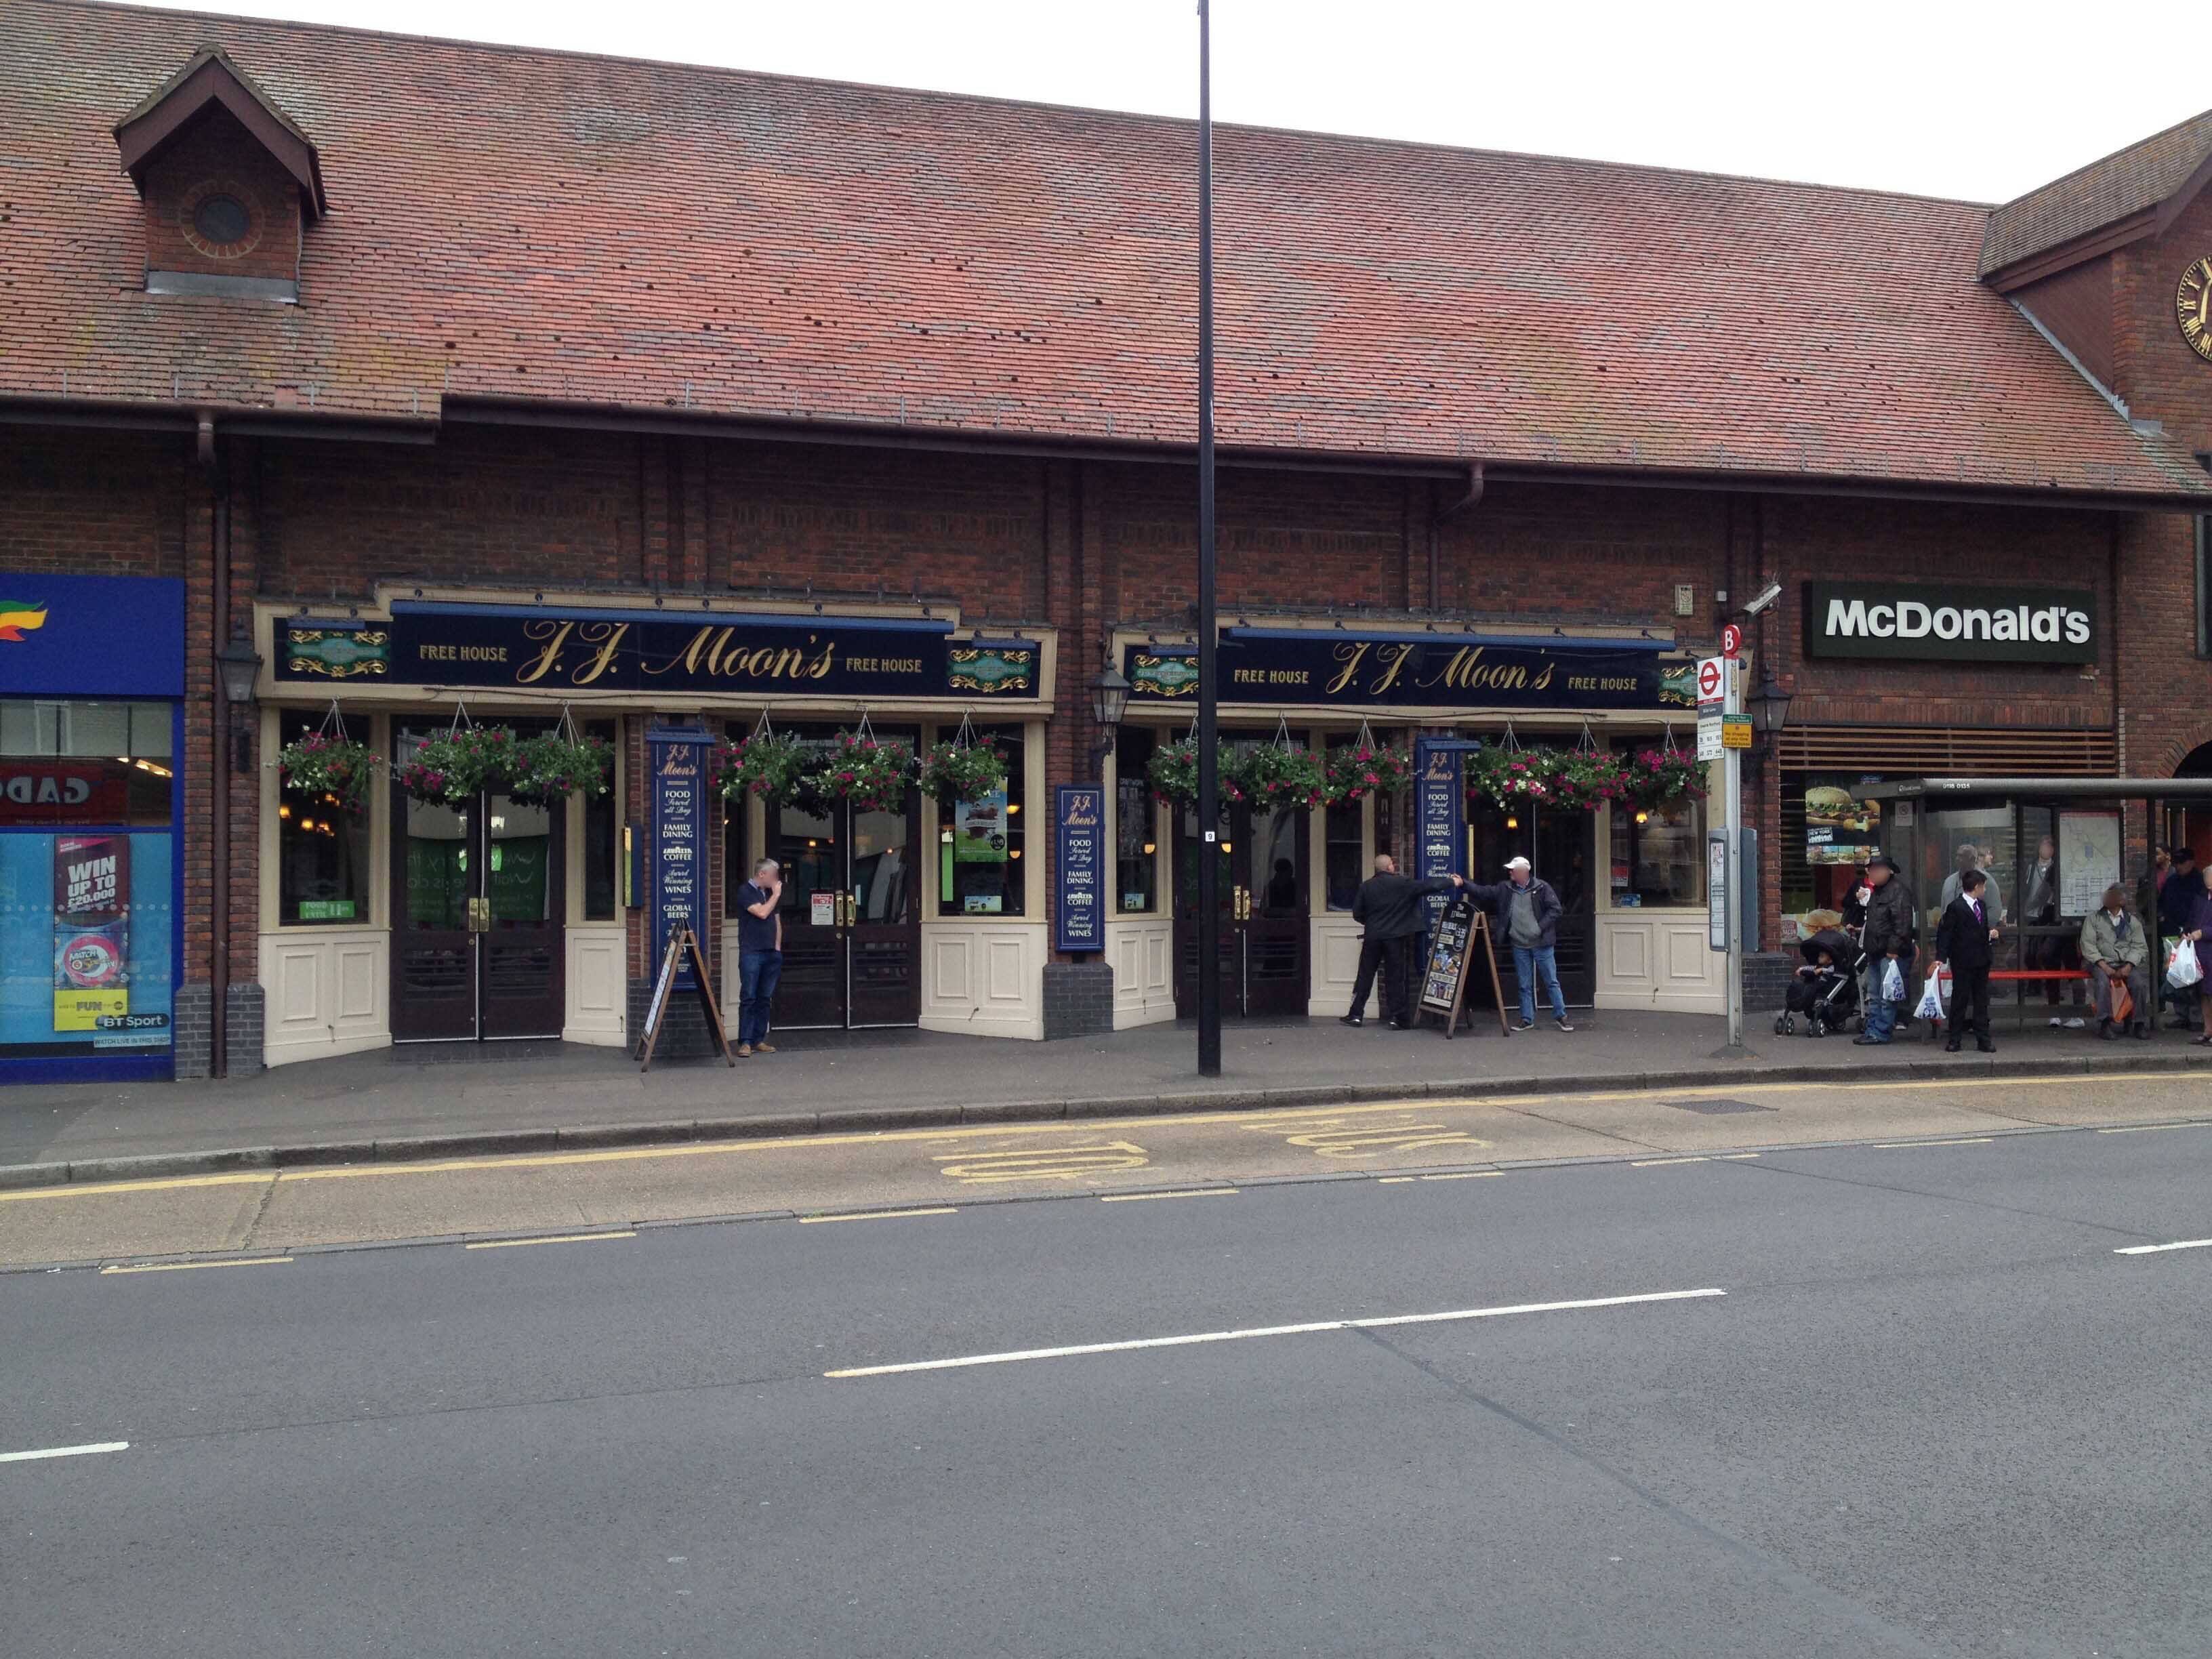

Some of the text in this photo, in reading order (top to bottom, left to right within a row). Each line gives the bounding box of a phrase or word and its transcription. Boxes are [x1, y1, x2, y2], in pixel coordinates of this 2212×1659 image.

[1825, 598, 2091, 644] McDonald's
[1725, 630, 1734, 651] B
[419, 644, 507, 662] FREE HOUSE
[640, 624, 835, 678] Moon's
[845, 658, 922, 674] FREE HOUSE
[1415, 645, 1556, 691] Moon's
[1233, 669, 1309, 685] FREE HOUSE
[1568, 677, 1637, 691] FREE HOUSE
[656, 760, 697, 777] Moon's
[1421, 769, 1454, 782] Moon's
[665, 790, 691, 798] FOOD
[1061, 811, 1097, 825] Moon's
[663, 823, 691, 832] FAMILY
[68, 855, 116, 883] WIN
[68, 874, 116, 897] UP TO
[664, 886, 692, 894] WINES
[76, 1001, 102, 1011] FUN
[104, 1015, 163, 1027] BT Sport
